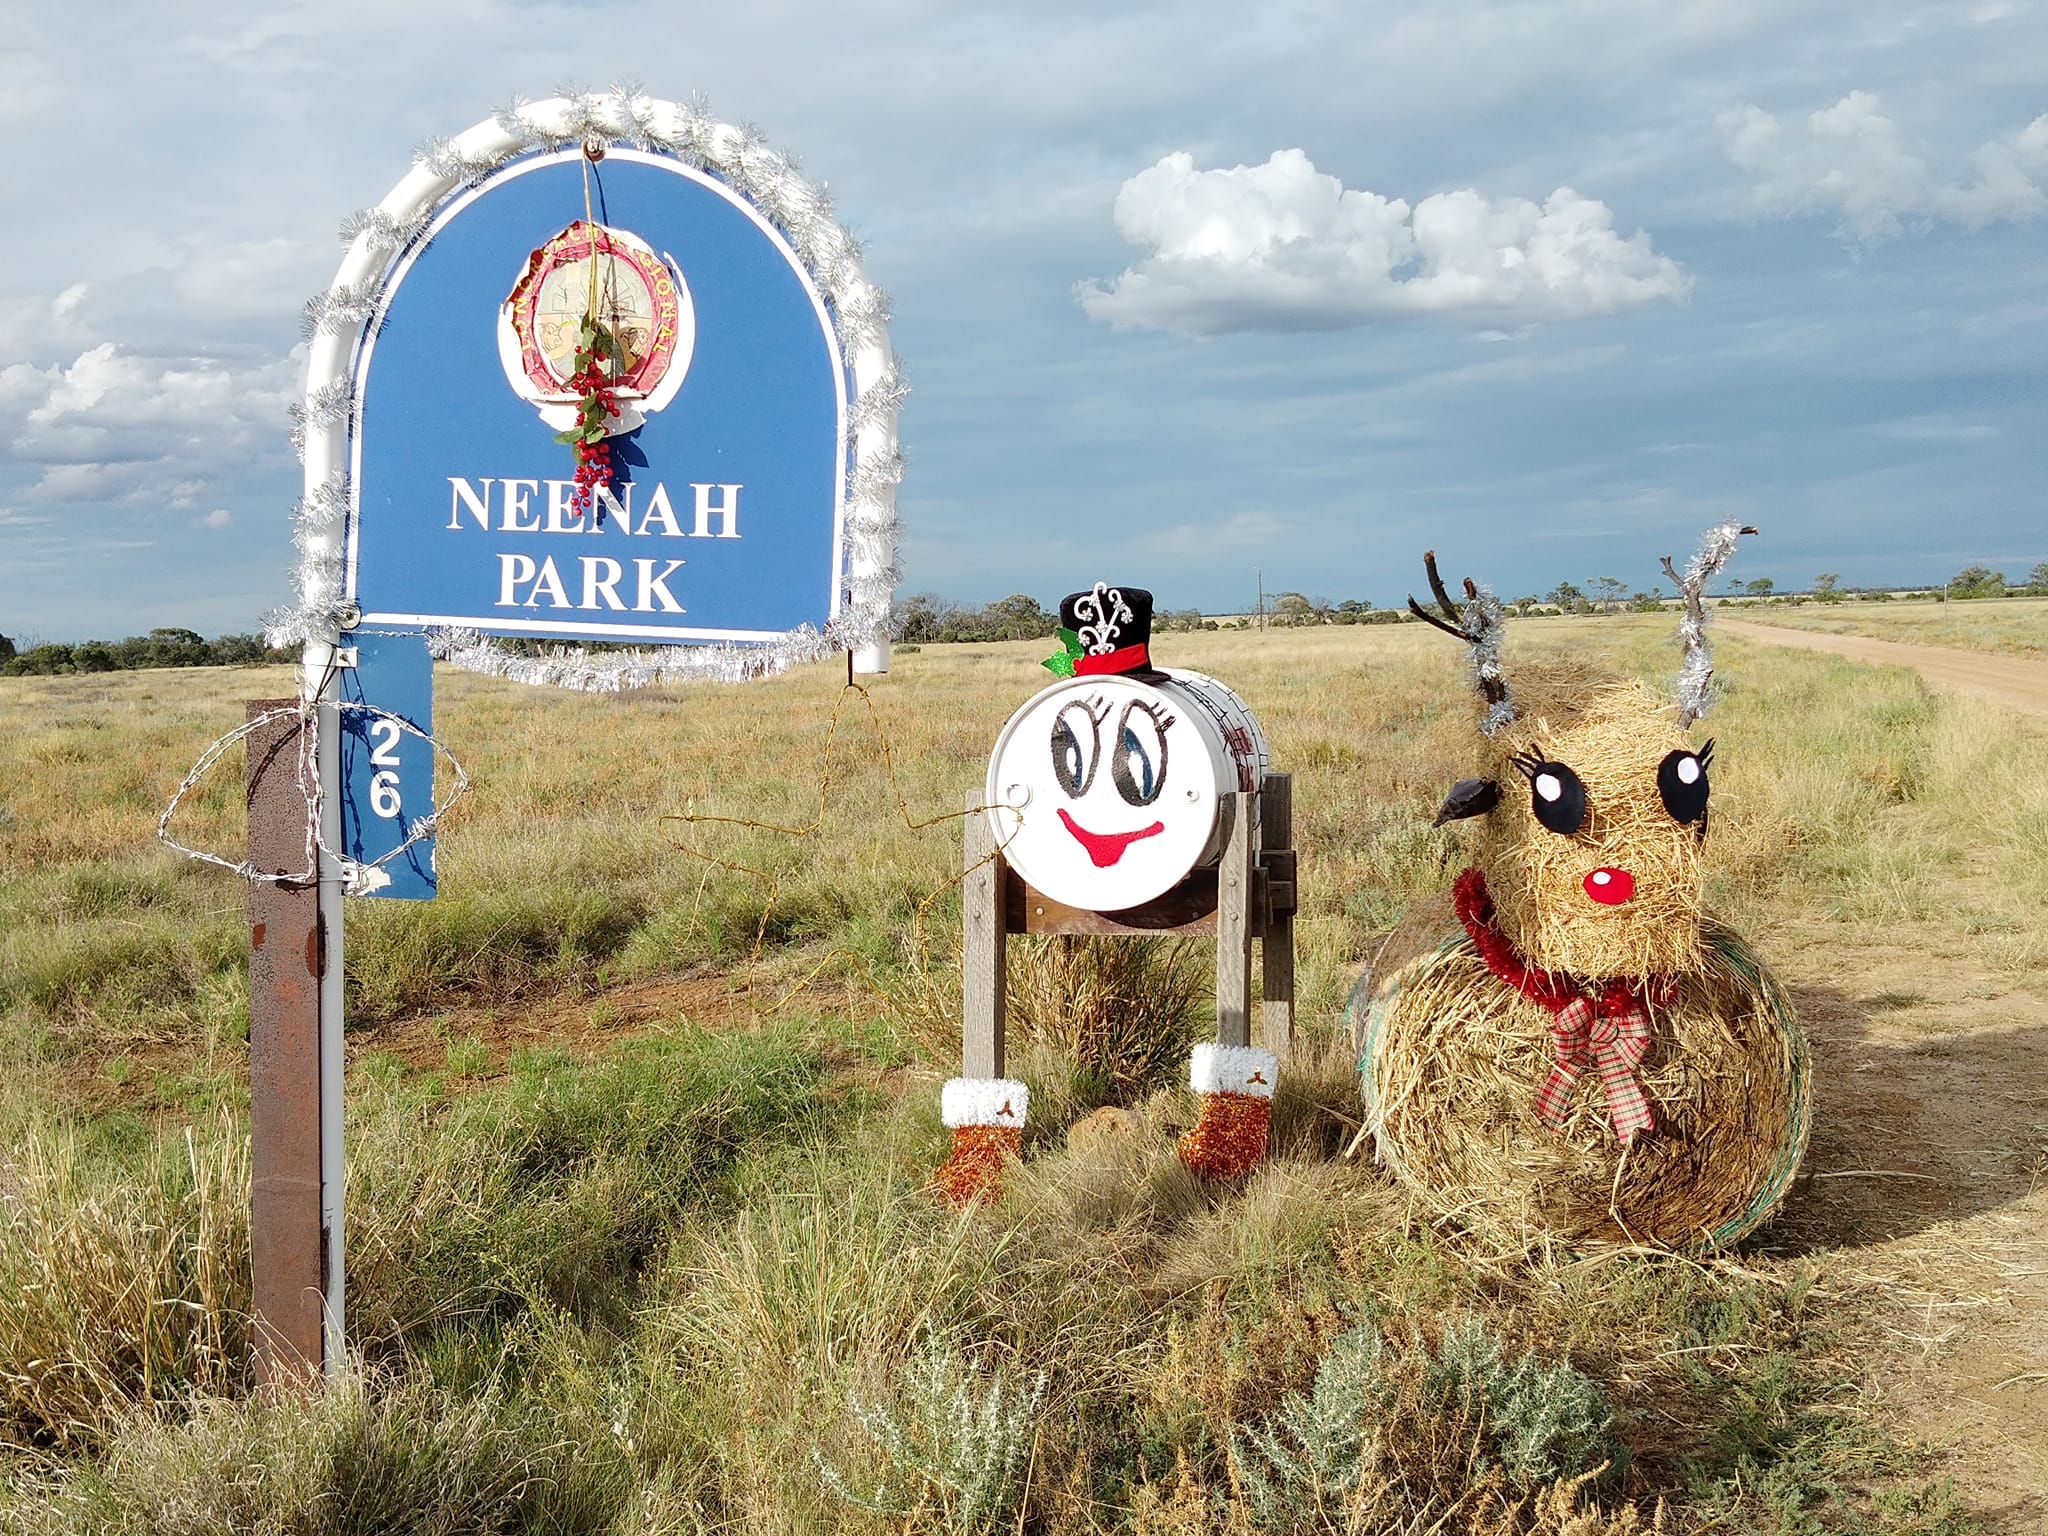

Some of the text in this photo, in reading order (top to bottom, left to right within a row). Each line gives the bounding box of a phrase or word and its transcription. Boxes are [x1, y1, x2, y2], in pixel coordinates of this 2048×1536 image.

[446, 477, 744, 539] NEENAH
[494, 553, 687, 614] PARK
[370, 718, 400, 818] 26
